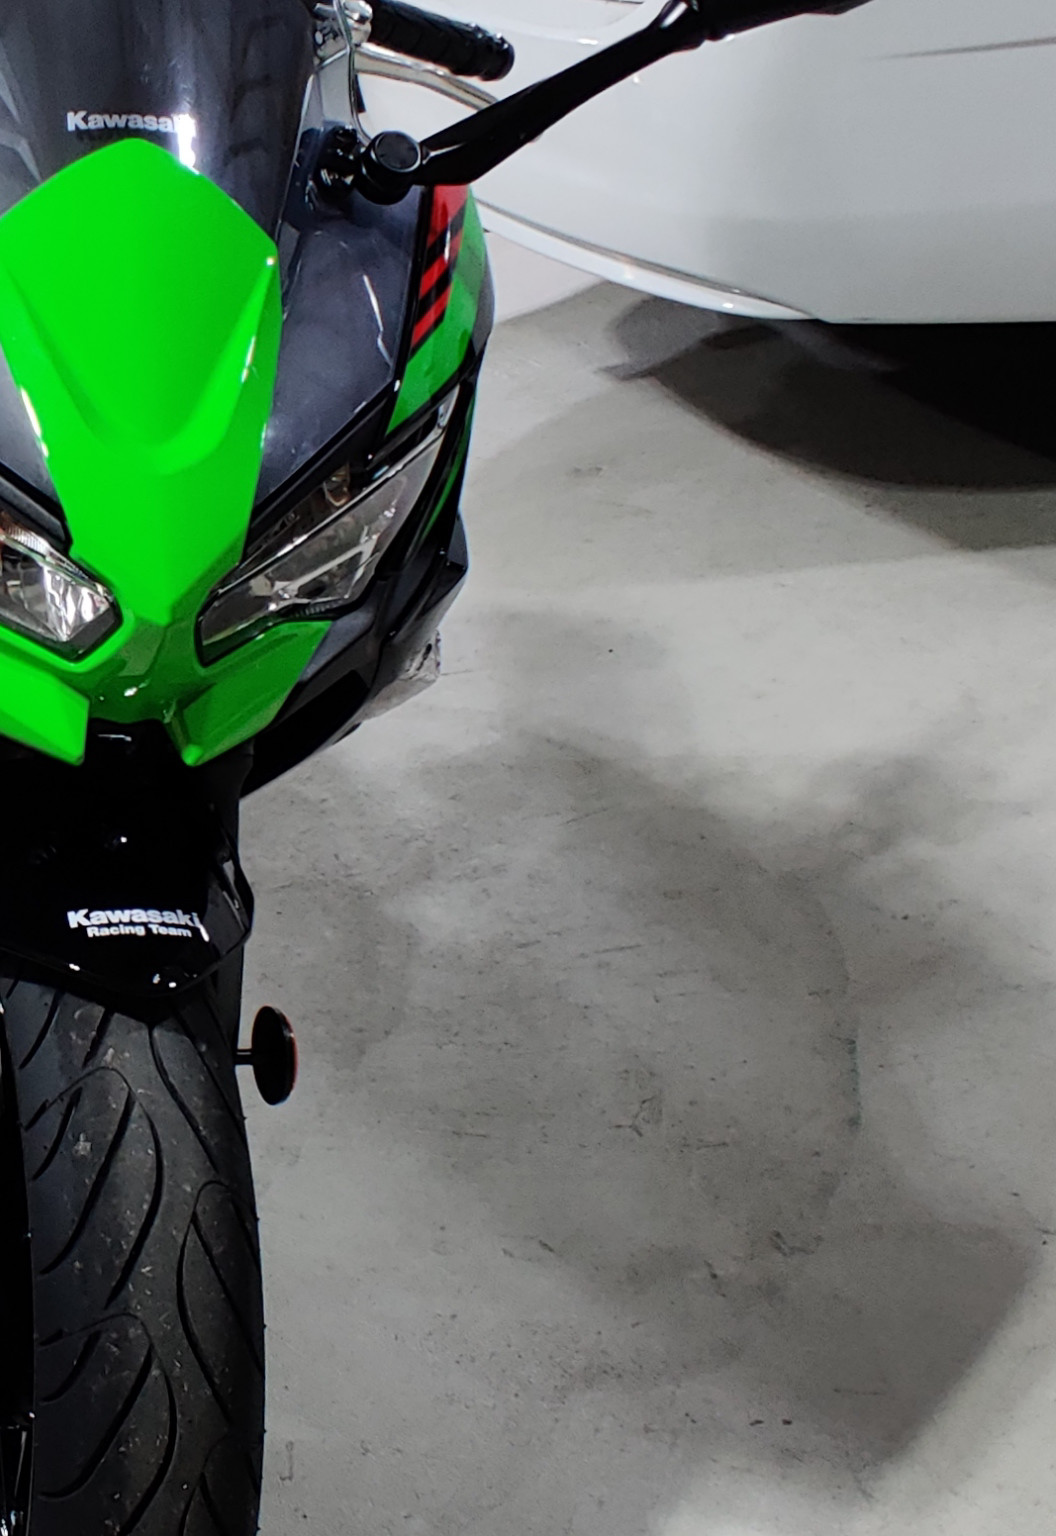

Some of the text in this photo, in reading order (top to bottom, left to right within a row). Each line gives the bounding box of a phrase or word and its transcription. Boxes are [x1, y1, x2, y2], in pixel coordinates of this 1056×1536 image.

[67, 110, 194, 134] Kawasa
[67, 908, 200, 929] Kawasaki
[86, 923, 192, 938] Racing Team
